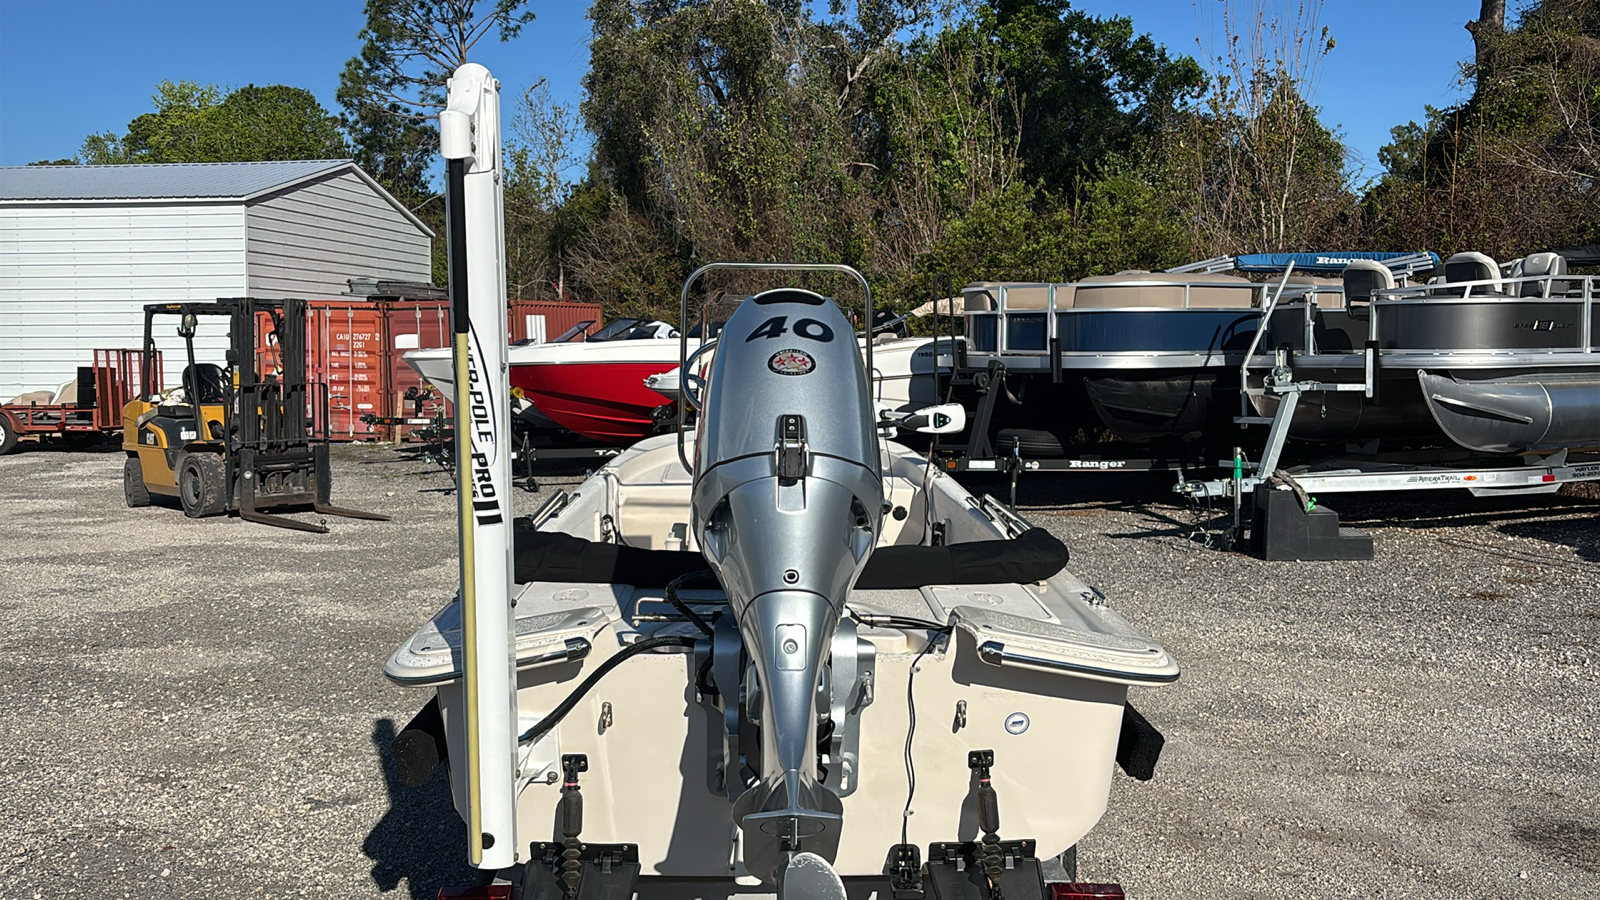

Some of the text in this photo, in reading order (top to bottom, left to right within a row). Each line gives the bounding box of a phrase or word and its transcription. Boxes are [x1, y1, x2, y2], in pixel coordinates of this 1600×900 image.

[353, 333, 371, 341] 276727
[745, 316, 834, 343] 40
[1069, 460, 1125, 470] Ranger
[471, 453, 496, 498] PRO
